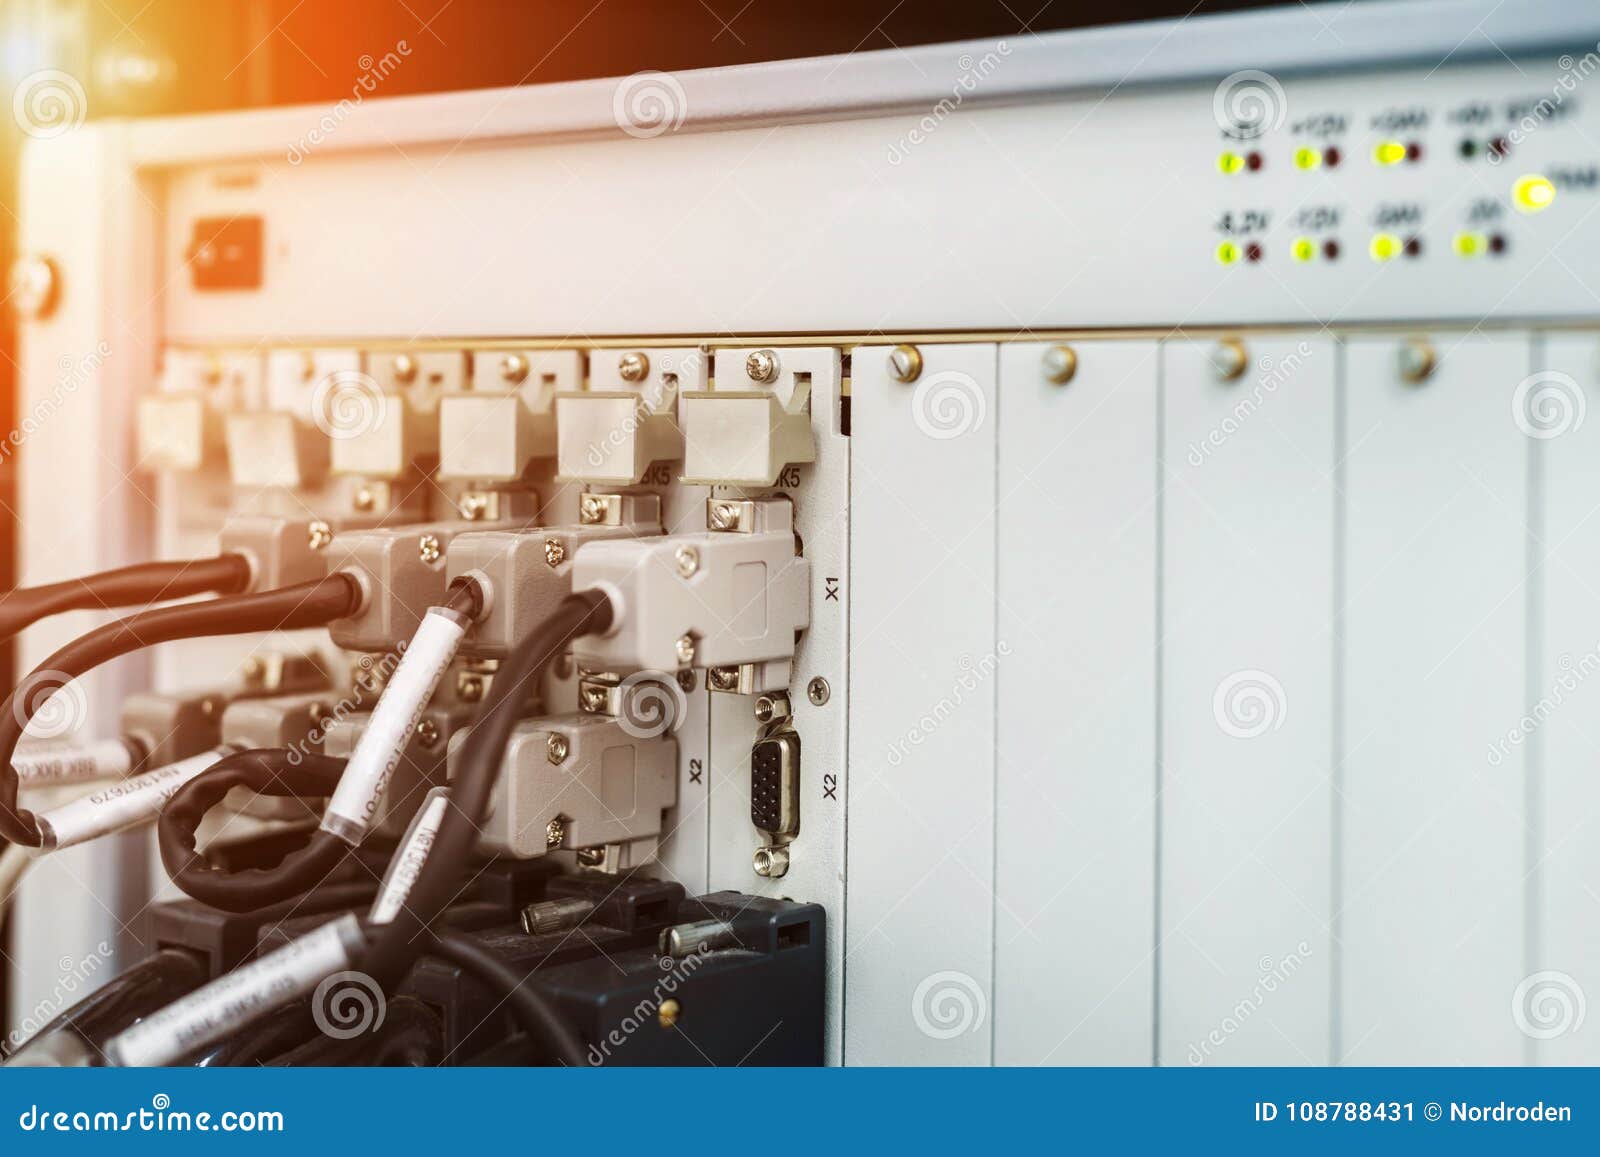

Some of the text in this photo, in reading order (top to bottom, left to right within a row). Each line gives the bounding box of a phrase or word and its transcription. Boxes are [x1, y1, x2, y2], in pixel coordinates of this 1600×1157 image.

[825, 576, 839, 602] X1
[689, 757, 703, 785] X2
[823, 773, 838, 801] X2
